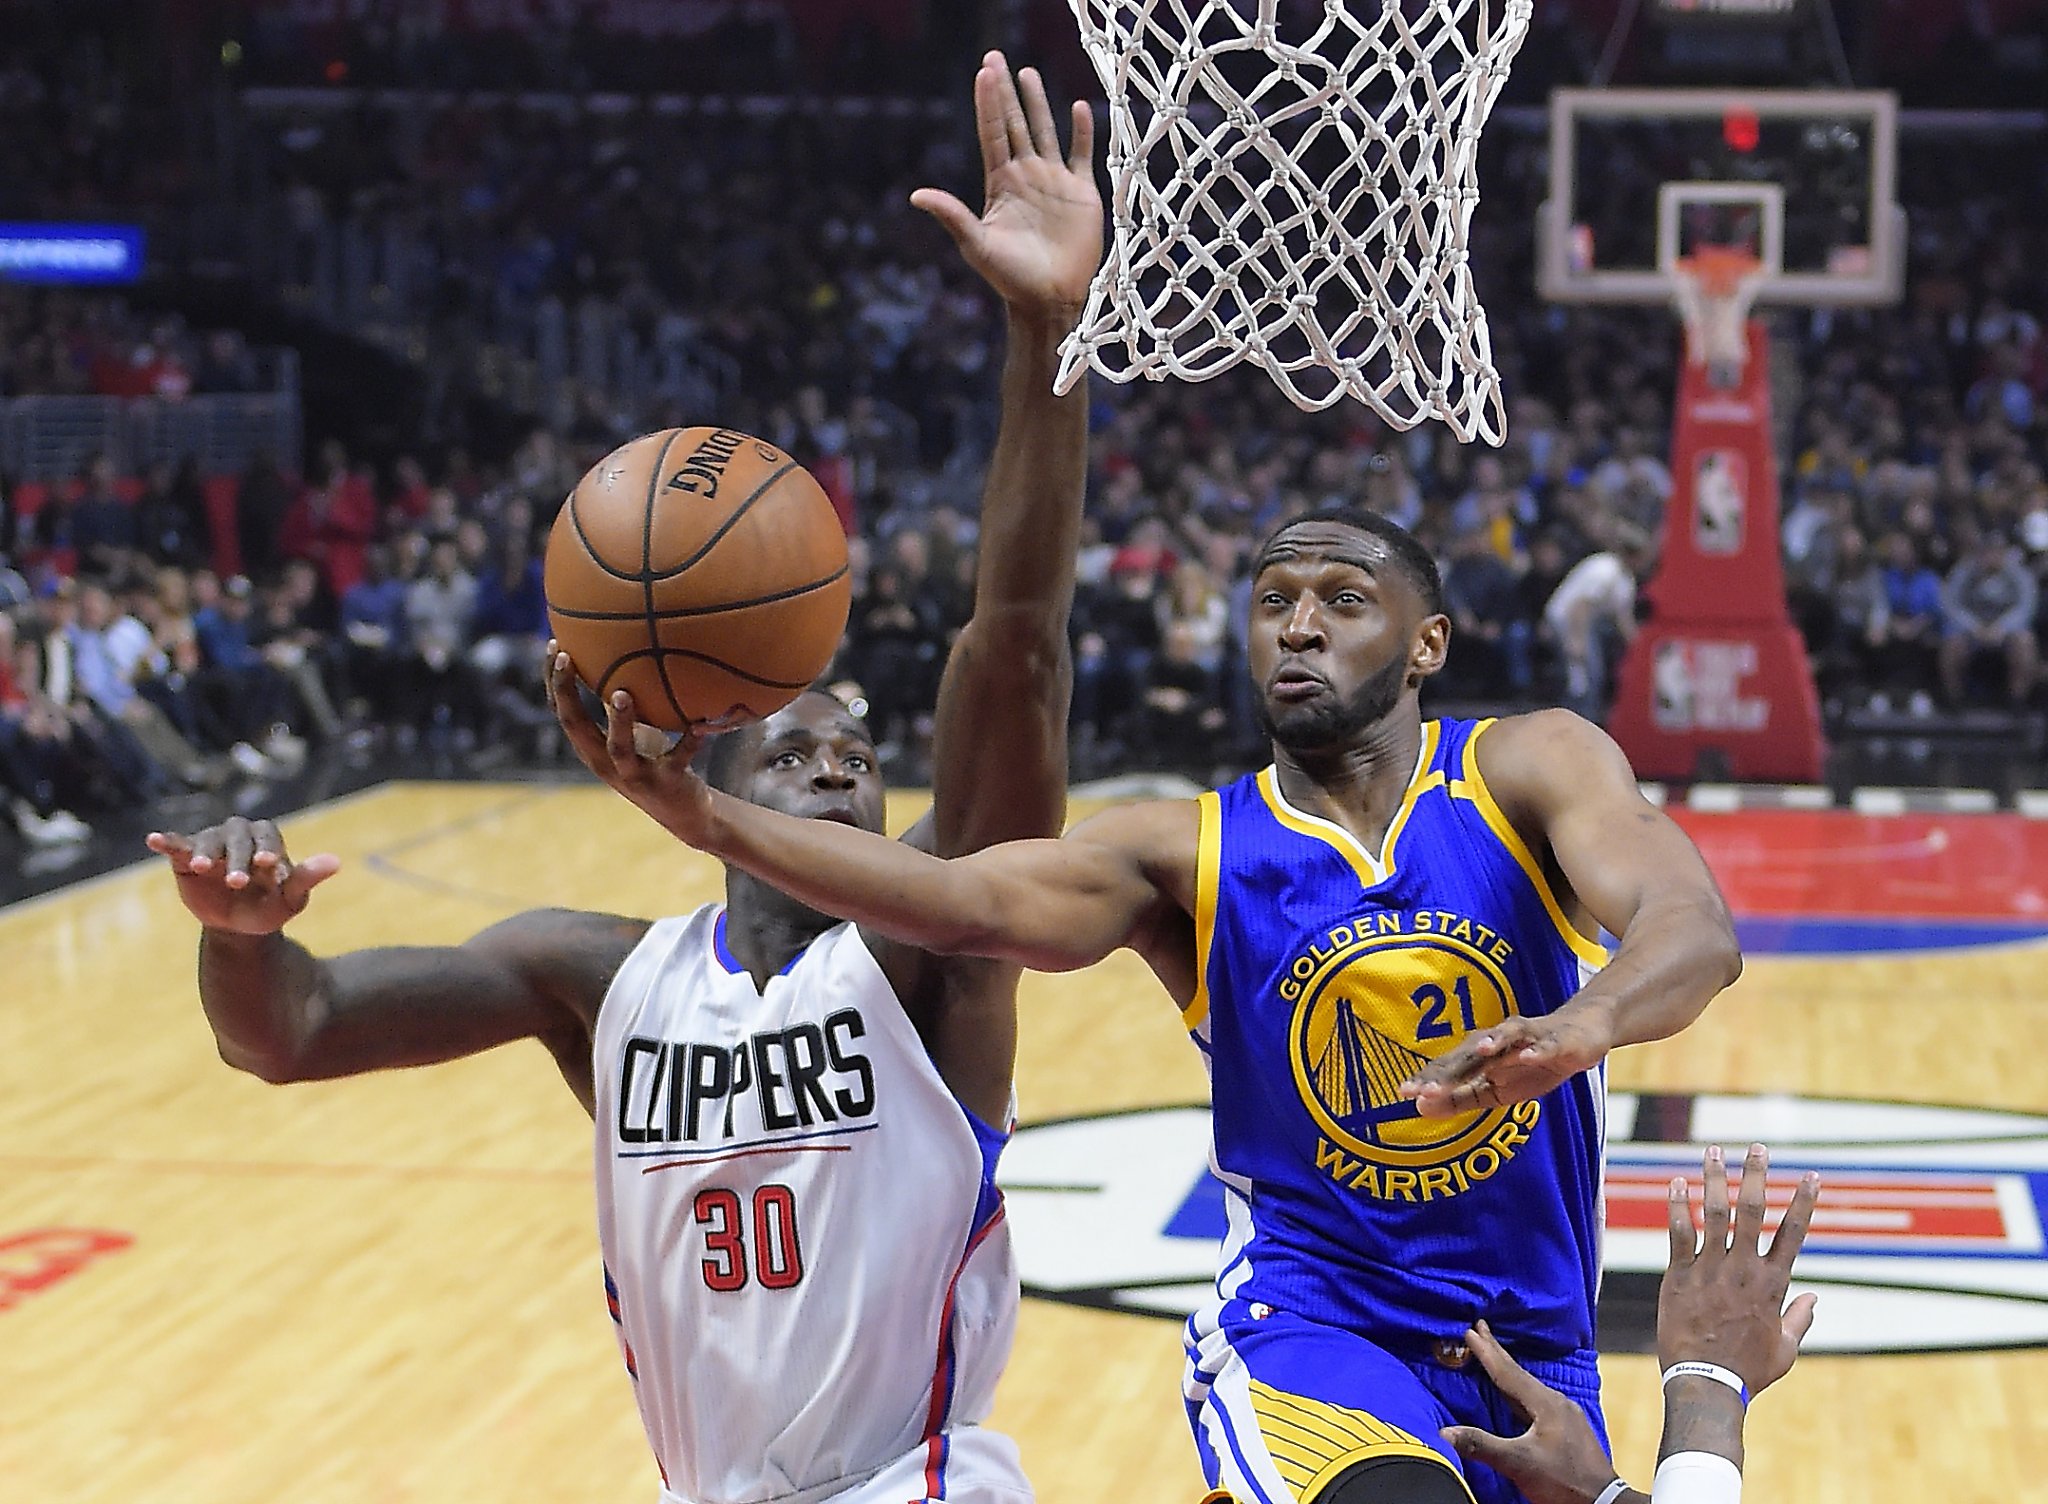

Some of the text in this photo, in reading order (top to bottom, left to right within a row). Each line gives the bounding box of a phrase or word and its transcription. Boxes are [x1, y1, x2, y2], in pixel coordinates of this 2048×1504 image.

[1279, 909, 1514, 1002] GOLDEN STATE
[1410, 975, 1477, 1042] 21
[618, 1006, 877, 1143] CLIPPERS
[1314, 1098, 1541, 1203] WARRIORS
[693, 1183, 805, 1292] 30
